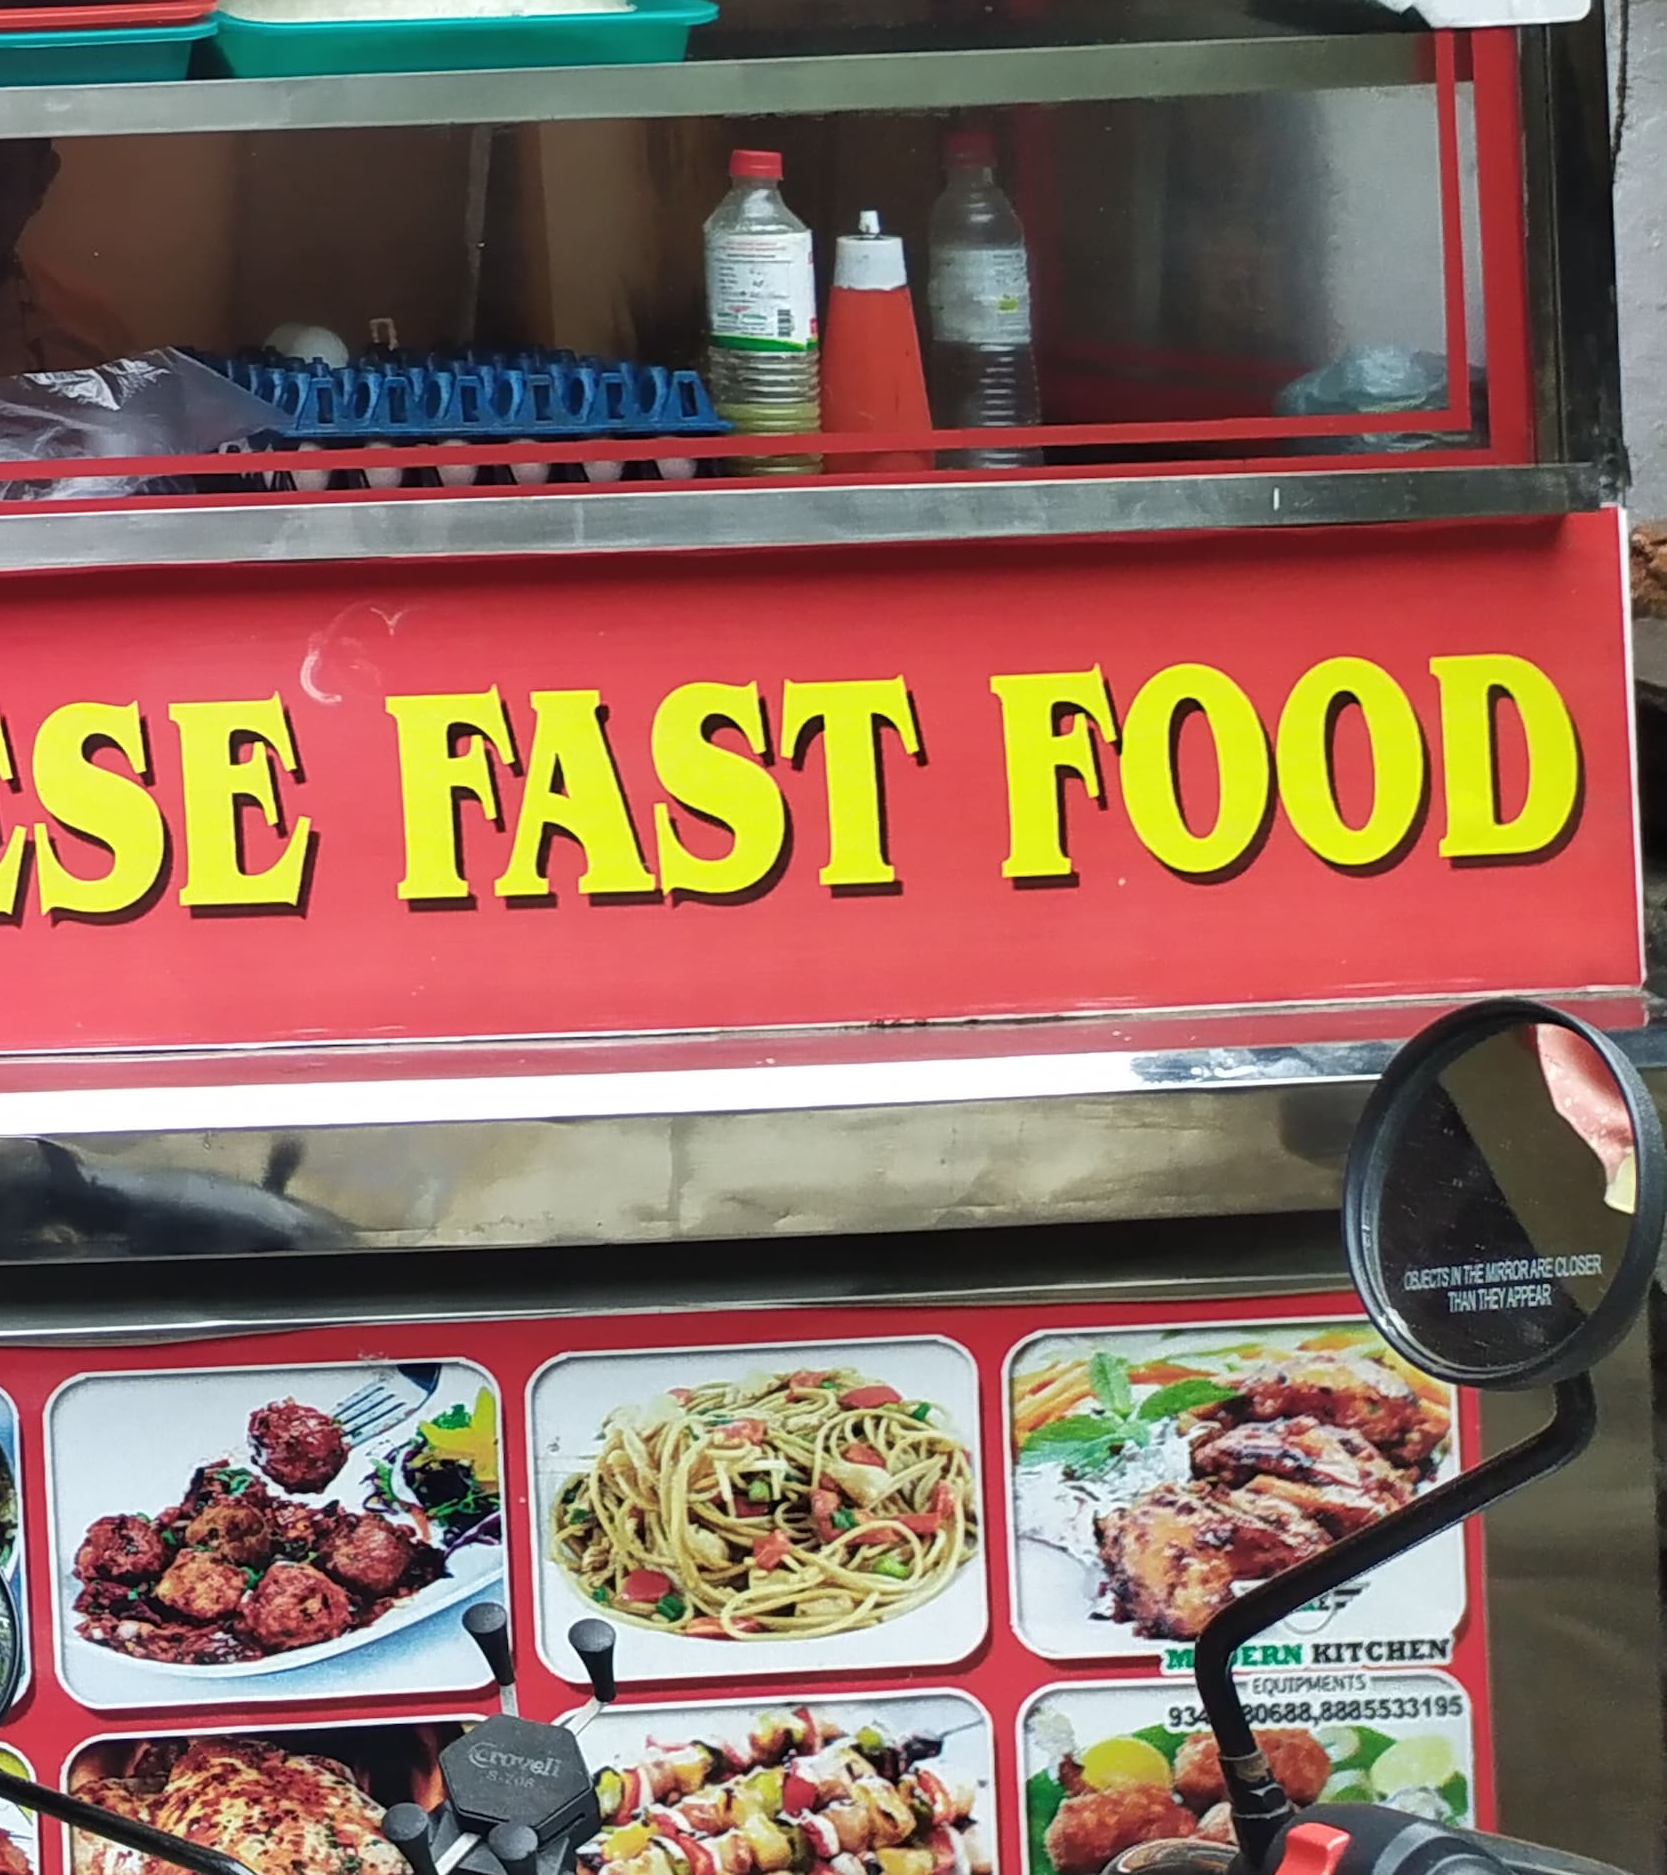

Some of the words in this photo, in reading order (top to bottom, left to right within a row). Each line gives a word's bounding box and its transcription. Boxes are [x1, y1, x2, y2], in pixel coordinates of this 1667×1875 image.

[387, 677, 919, 899] FAST
[991, 656, 1577, 877] FOOD
[1404, 1267, 1449, 1290] OBJECTS
[1451, 1266, 1461, 1286] IN
[1463, 1264, 1483, 1284] THE
[1486, 1260, 1530, 1282] MIRROR
[1531, 1258, 1553, 1279] ARE
[1555, 1254, 1602, 1277] CLOSER
[1448, 1290, 1476, 1312] THAN
[1478, 1287, 1506, 1310] THEY
[1508, 1284, 1552, 1307] APPEAR
[1165, 1643, 1303, 1669] MERN
[1311, 1638, 1450, 1664] KITCHEN
[1252, 1674, 1367, 1697] EQUIPMENTS
[1168, 1695, 1464, 1727] 93480688,8885533195
